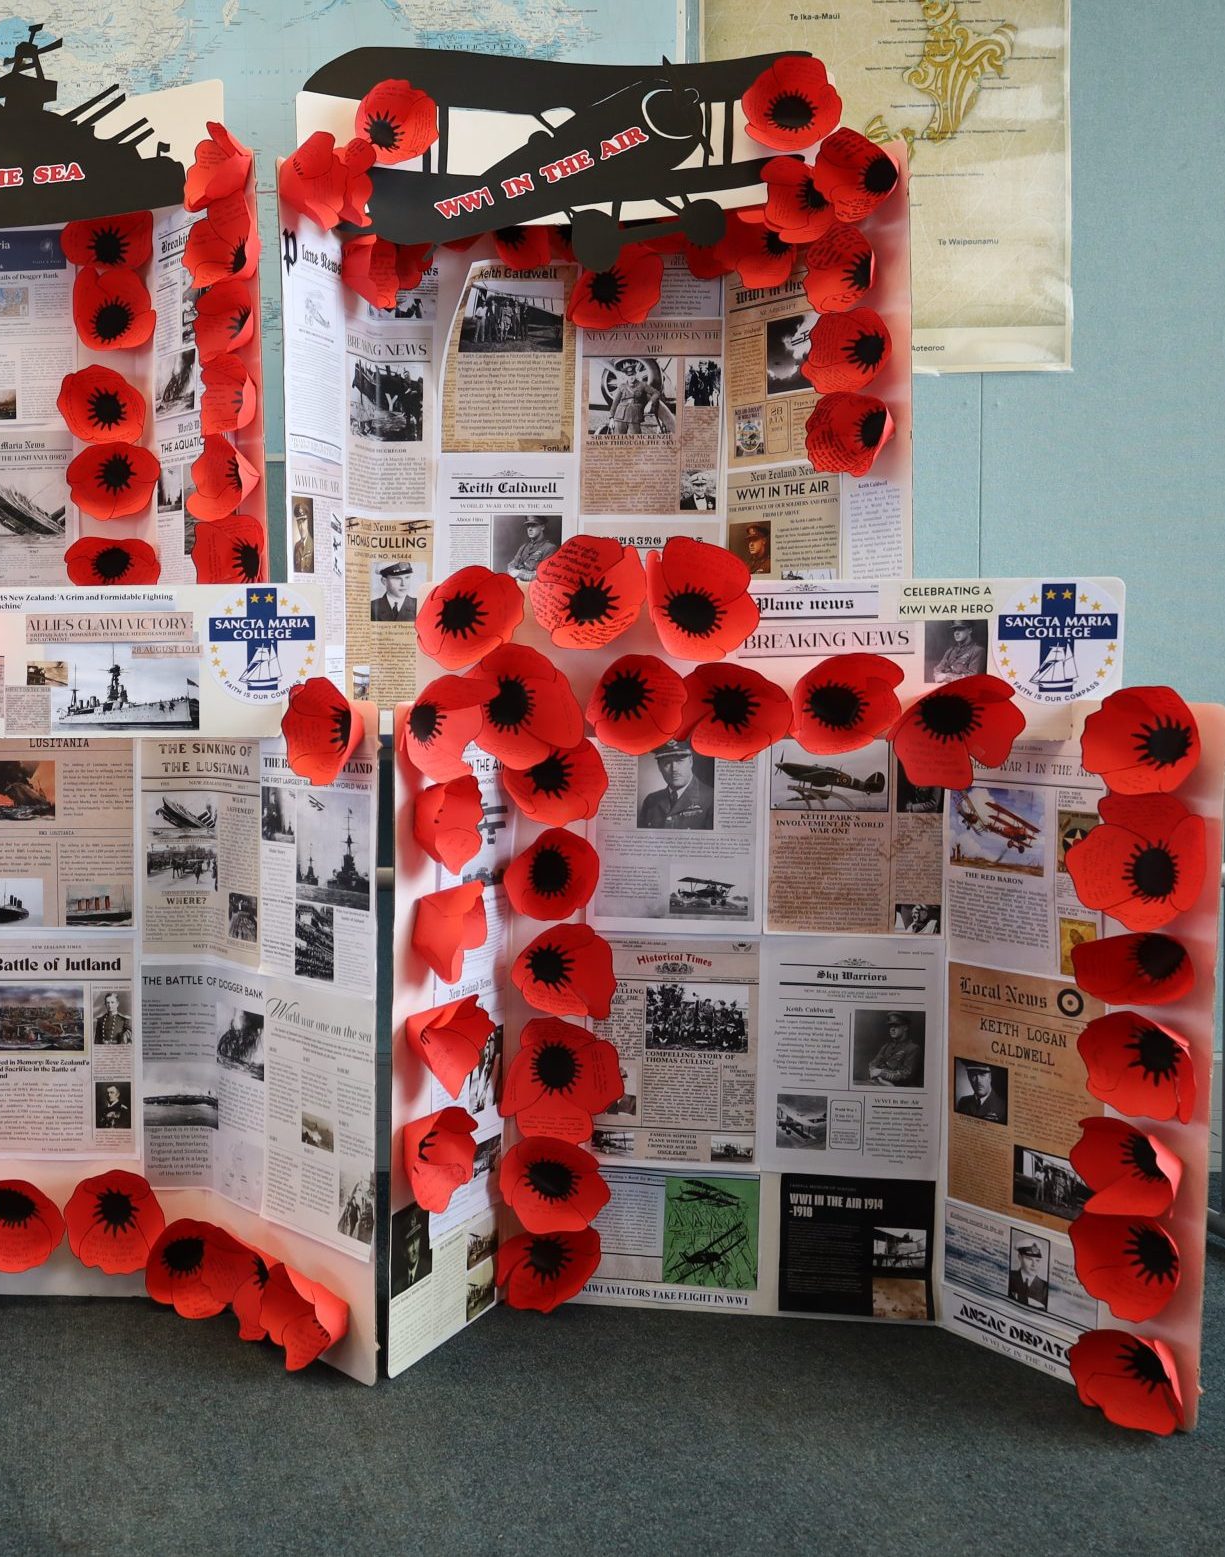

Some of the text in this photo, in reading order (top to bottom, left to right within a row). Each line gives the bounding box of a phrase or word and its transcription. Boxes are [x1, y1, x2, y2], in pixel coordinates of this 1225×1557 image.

[789, 12, 841, 21] Te Ika-a-Maui
[32, 162, 86, 185] SEA
[434, 125, 650, 221] WW1 IN THE AIR
[948, 238, 999, 247] Waipounamu
[458, 481, 557, 495] Keith Caldwell
[736, 480, 829, 501] WW1 IN THE AIR
[346, 534, 427, 548] THOMAS CULLING
[100, 593, 141, 601] Formidable
[142, 593, 173, 602] Fighting
[903, 585, 992, 598] CELEBRATING A
[757, 596, 855, 612] Plane news
[898, 602, 994, 615] KIWI WAR HERO
[27, 618, 193, 632] ALLIES CLAIM VICTORY:
[214, 618, 310, 630] SANCTA MARIA
[1004, 615, 1112, 628] SANCTA MARIA
[232, 629, 293, 640] COLLEGE
[744, 628, 910, 651] BREAKING NEWS
[1024, 626, 1092, 639] COLLEGE
[29, 738, 90, 749] LUSITANIA
[158, 743, 252, 757] THE SINKING OF
[161, 762, 250, 776] THE LUSITANIA
[965, 871, 1024, 885] THE RED BARON
[44, 957, 59, 971] of
[65, 957, 122, 971] Jutland
[637, 953, 713, 968] Historical Times
[816, 970, 887, 983] Sky Warriors
[143, 976, 264, 1000] THE BATTLE OF DOGGER BANK
[959, 975, 1048, 1009] Local News
[266, 997, 372, 1044] World war one on the sea
[979, 1018, 1067, 1048] KEITH LOGAN
[991, 1041, 1055, 1066] CALDWELL
[814, 1194, 825, 1206] IN
[826, 1196, 844, 1208] THE
[845, 1197, 862, 1209] AIR
[863, 1197, 884, 1210] 1914
[789, 1205, 813, 1218] -1918
[582, 1283, 749, 1307] KIWI AVIATORS TAKE FLIGHT IN WW1
